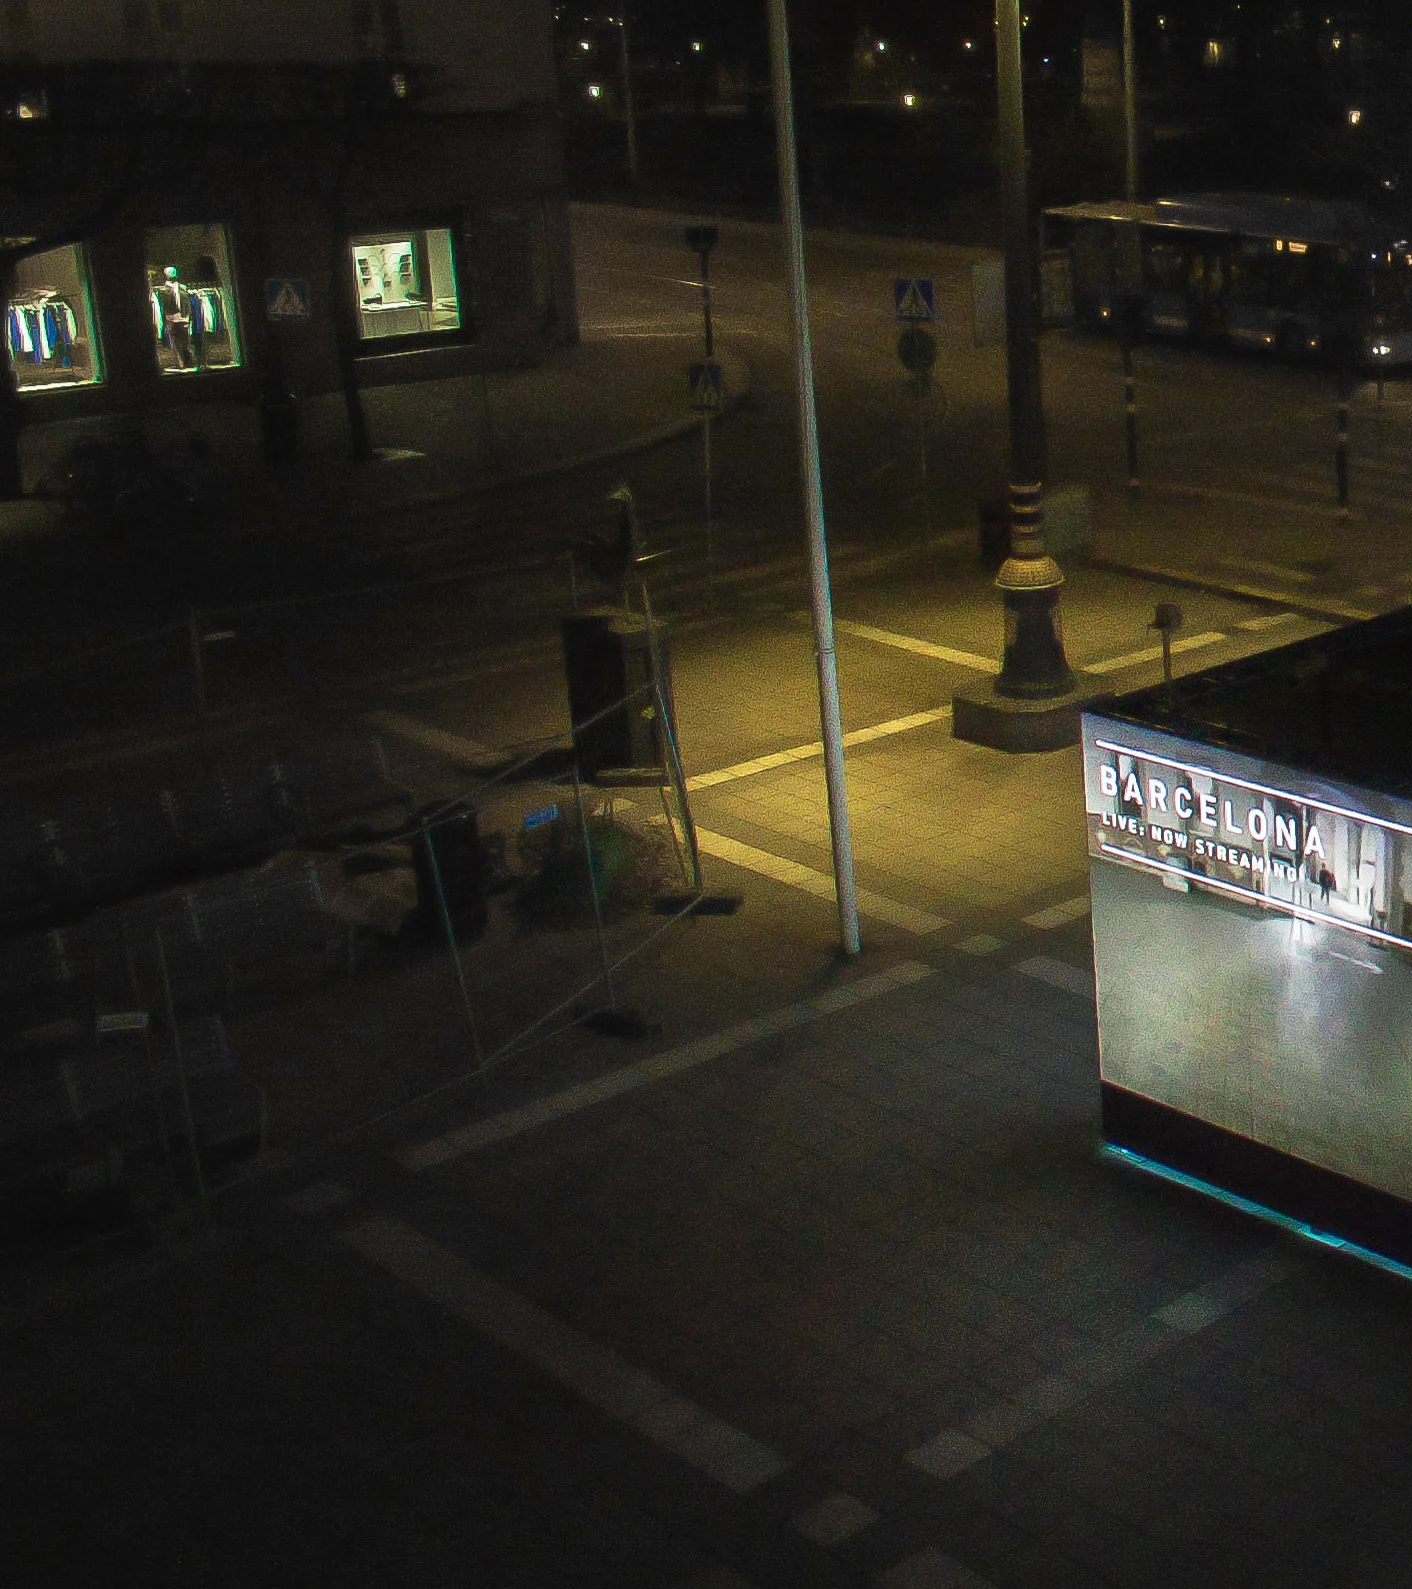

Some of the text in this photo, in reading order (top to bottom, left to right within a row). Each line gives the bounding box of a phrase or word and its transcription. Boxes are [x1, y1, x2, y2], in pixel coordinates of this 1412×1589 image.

[1100, 763, 1326, 859] BARCELONA
[1151, 824, 1188, 849] NOW
[1194, 838, 1298, 883] STREAMING
